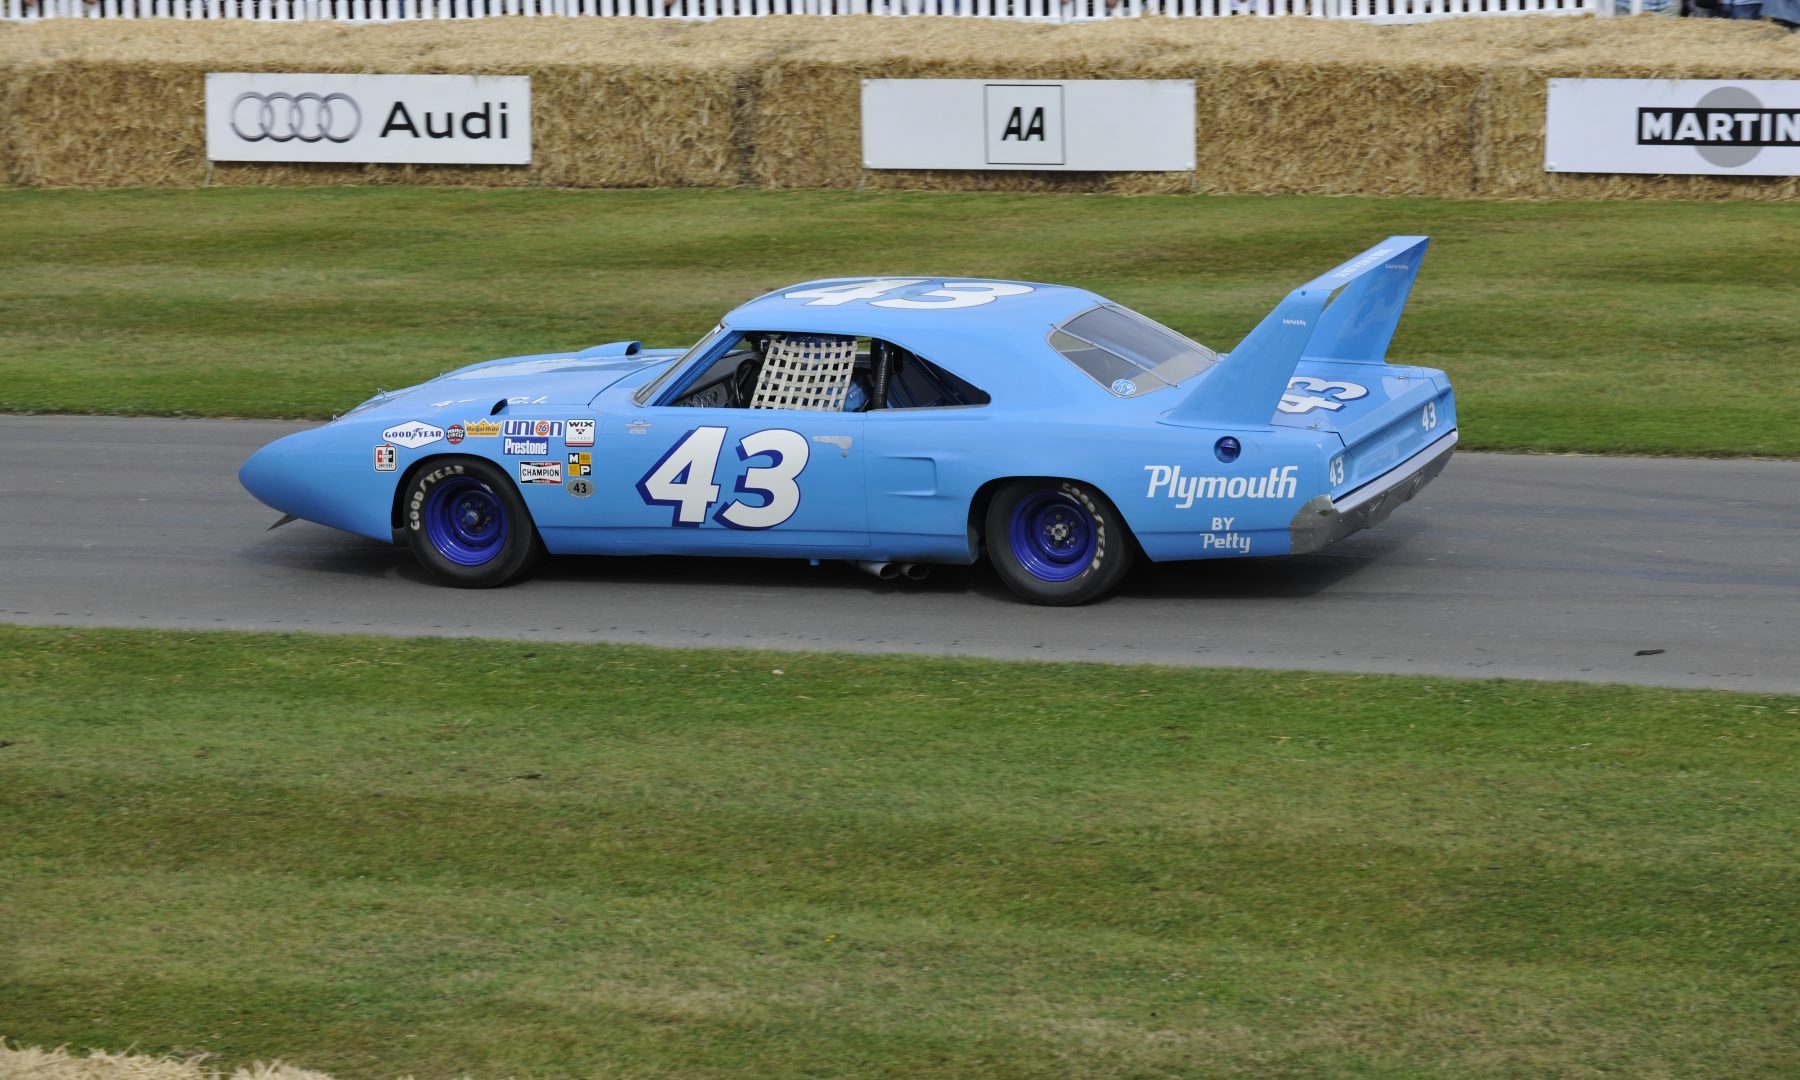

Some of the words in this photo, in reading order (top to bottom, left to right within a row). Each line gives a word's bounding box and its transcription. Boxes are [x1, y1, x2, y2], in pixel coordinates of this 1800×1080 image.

[379, 101, 509, 139] Audi
[1001, 107, 1046, 142] AA
[1641, 112, 1800, 142] MARTIN
[784, 279, 1037, 309] 43
[1422, 401, 1437, 432] 43
[504, 438, 547, 454] Prestone
[522, 469, 560, 477] CHAMPION
[635, 425, 811, 531] 43
[1329, 456, 1345, 487] 43
[573, 482, 587, 494] 43
[1144, 465, 1299, 509] Plymouth
[1212, 517, 1235, 531] BY
[1200, 533, 1251, 554] Petty
